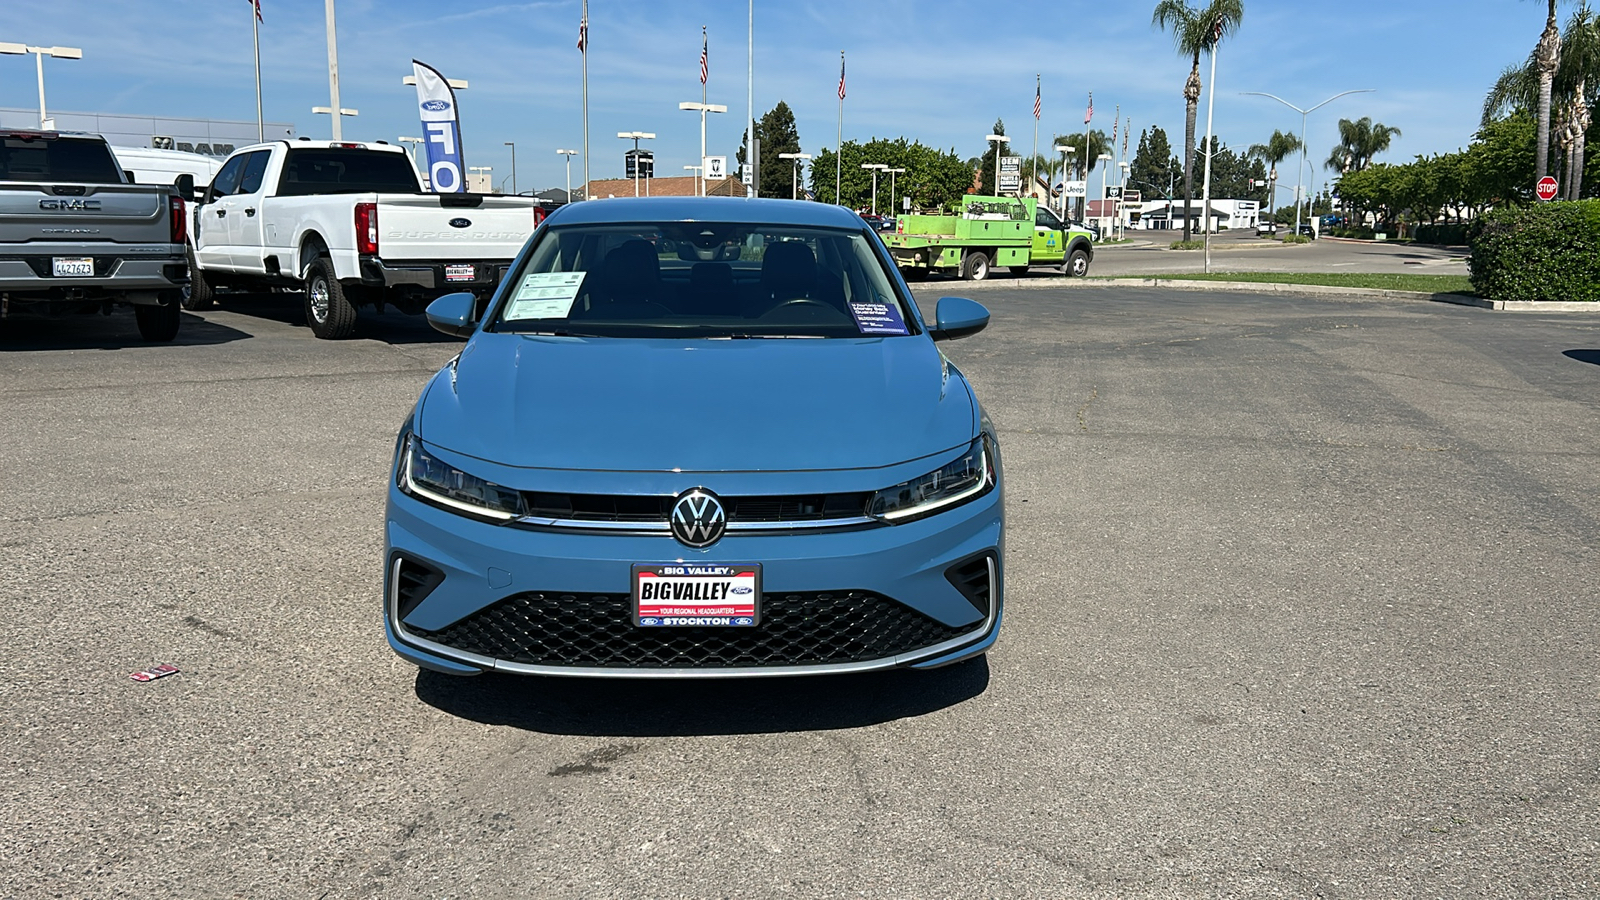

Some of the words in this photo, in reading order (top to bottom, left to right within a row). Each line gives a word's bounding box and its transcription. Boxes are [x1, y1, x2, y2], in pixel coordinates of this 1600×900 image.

[176, 142, 236, 156] RAM
[1067, 186, 1085, 194] Jeep
[1538, 183, 1556, 193] STOP
[39, 199, 101, 211] GMC
[388, 231, 468, 240] SUPER
[473, 231, 527, 240] DUTY
